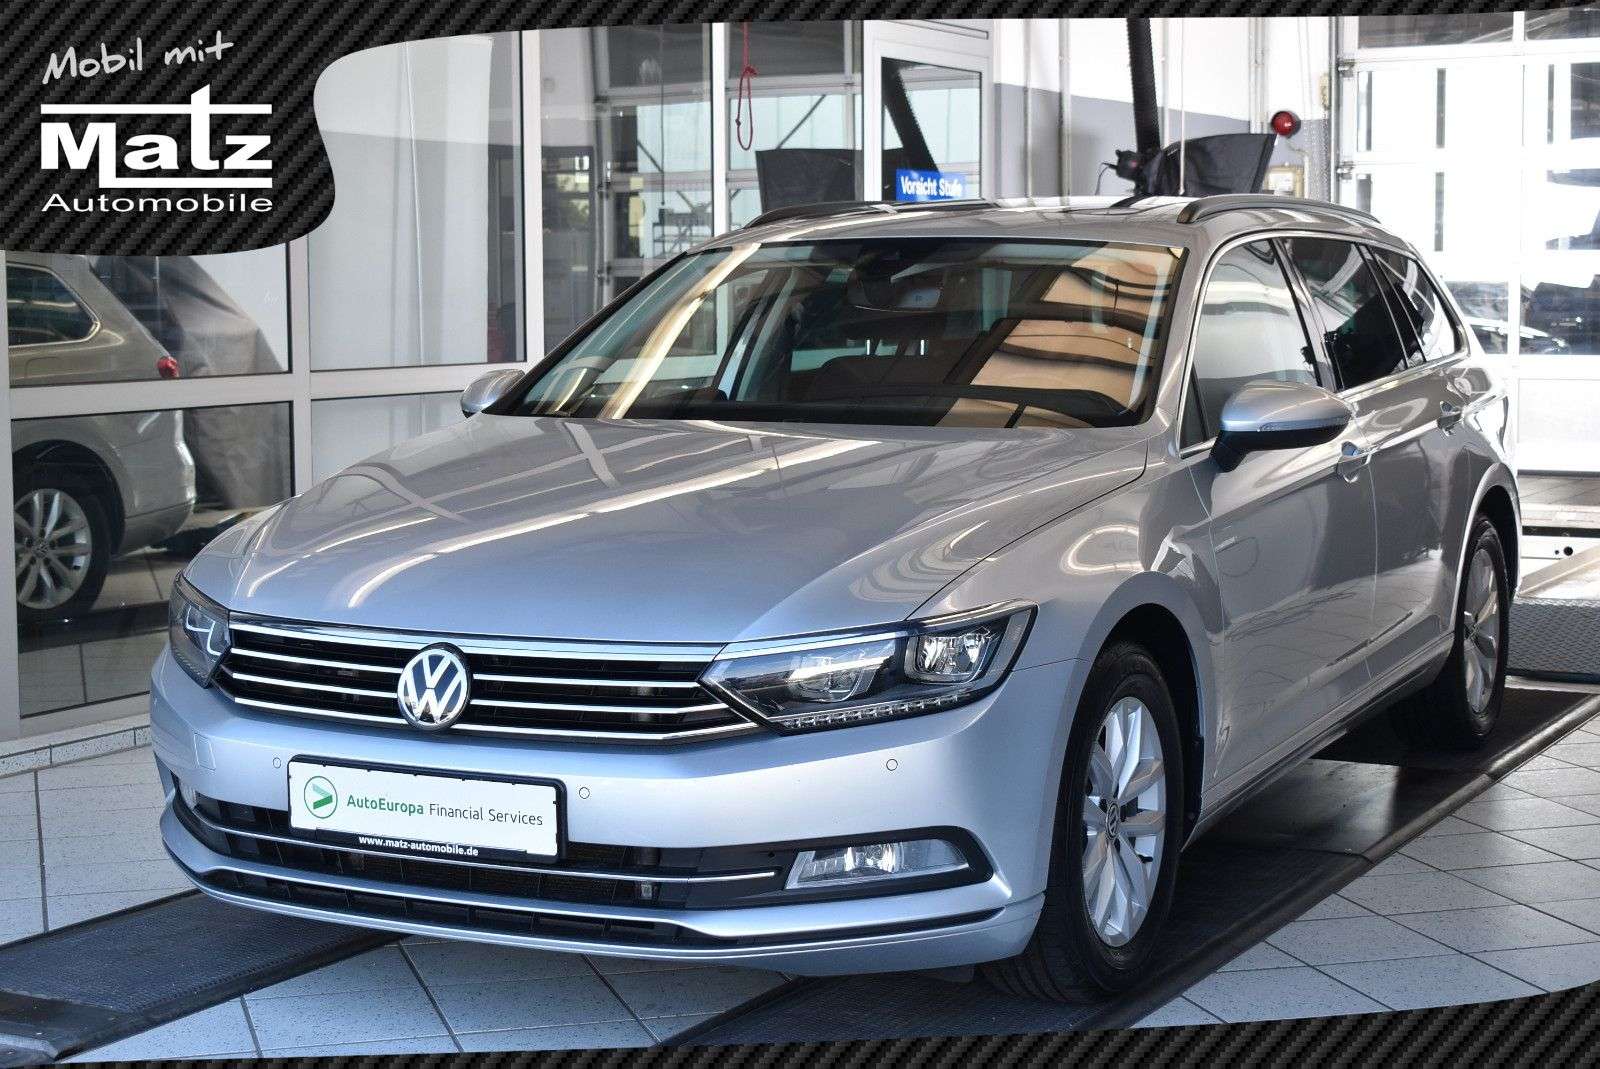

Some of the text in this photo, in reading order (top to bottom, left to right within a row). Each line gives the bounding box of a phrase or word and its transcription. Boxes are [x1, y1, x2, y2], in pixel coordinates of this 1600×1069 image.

[900, 176, 937, 196] Vorsicht
[346, 794, 544, 826] AutoEuropa Financial Services
[358, 835, 479, 856] www.matz-automobile.de
